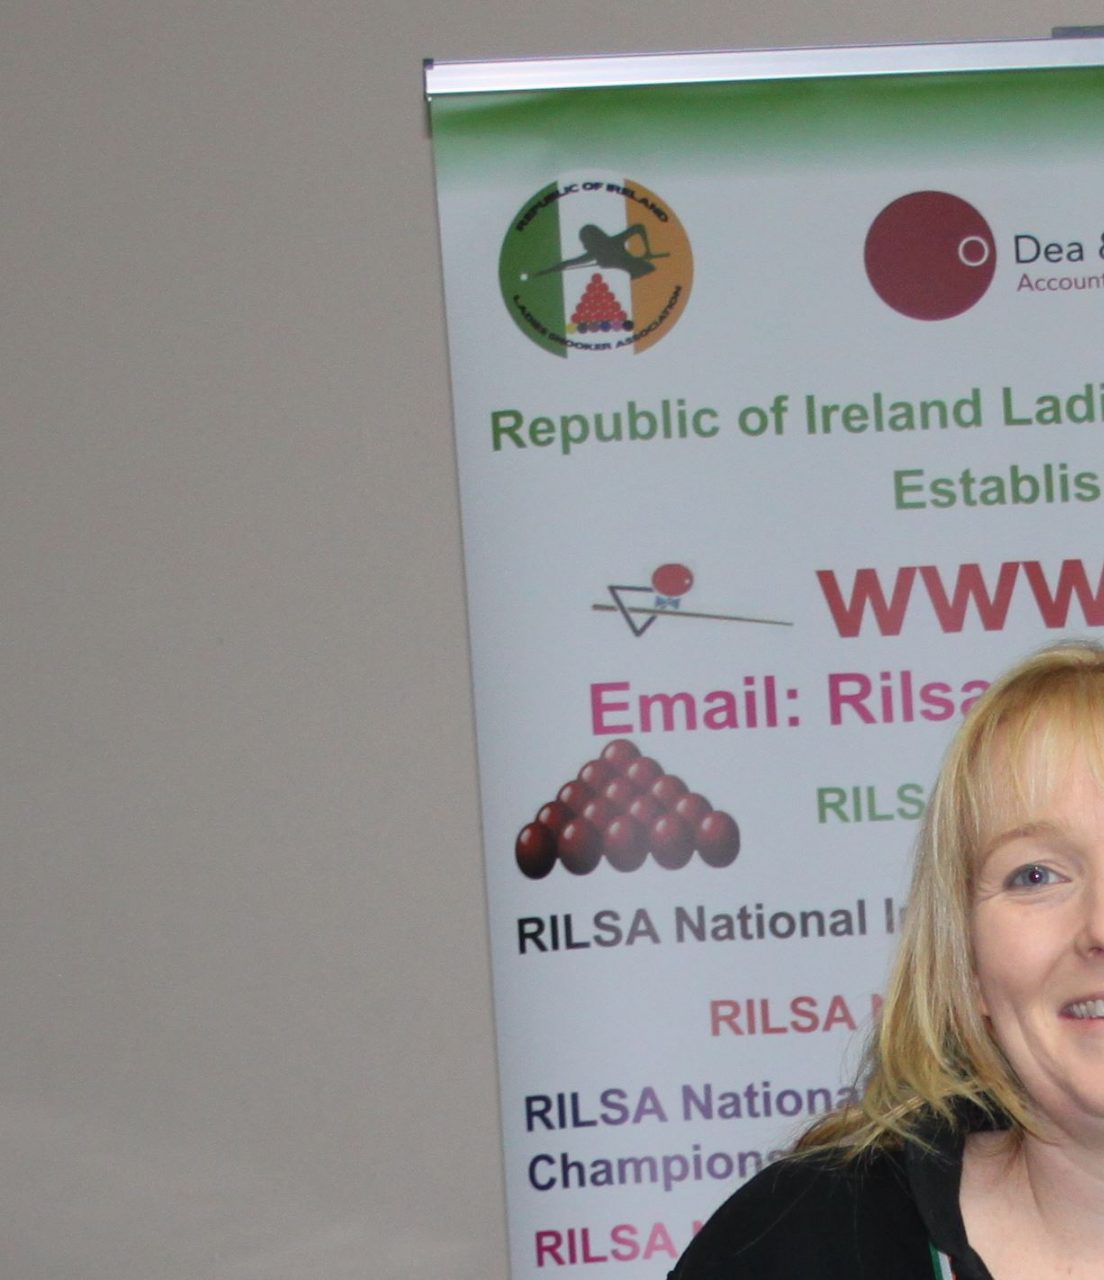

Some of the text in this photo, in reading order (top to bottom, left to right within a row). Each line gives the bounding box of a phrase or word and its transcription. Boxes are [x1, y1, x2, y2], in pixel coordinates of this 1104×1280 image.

[515, 182, 669, 232] REPUBLIC OF IRELAND
[1013, 234, 1084, 264] Dea
[615, 285, 682, 349] ASSOCIATION
[490, 397, 720, 456] Republic
[737, 394, 788, 438] of
[805, 387, 983, 435] Ireland
[589, 675, 800, 736] Email:
[816, 783, 926, 824] RILS
[516, 907, 661, 955] RILSA
[674, 899, 868, 944] National
[709, 994, 859, 1037] RILSA
[524, 1086, 668, 1133] RILSA
[681, 1081, 861, 1121] Nationa
[535, 1221, 678, 1268] RILSA
